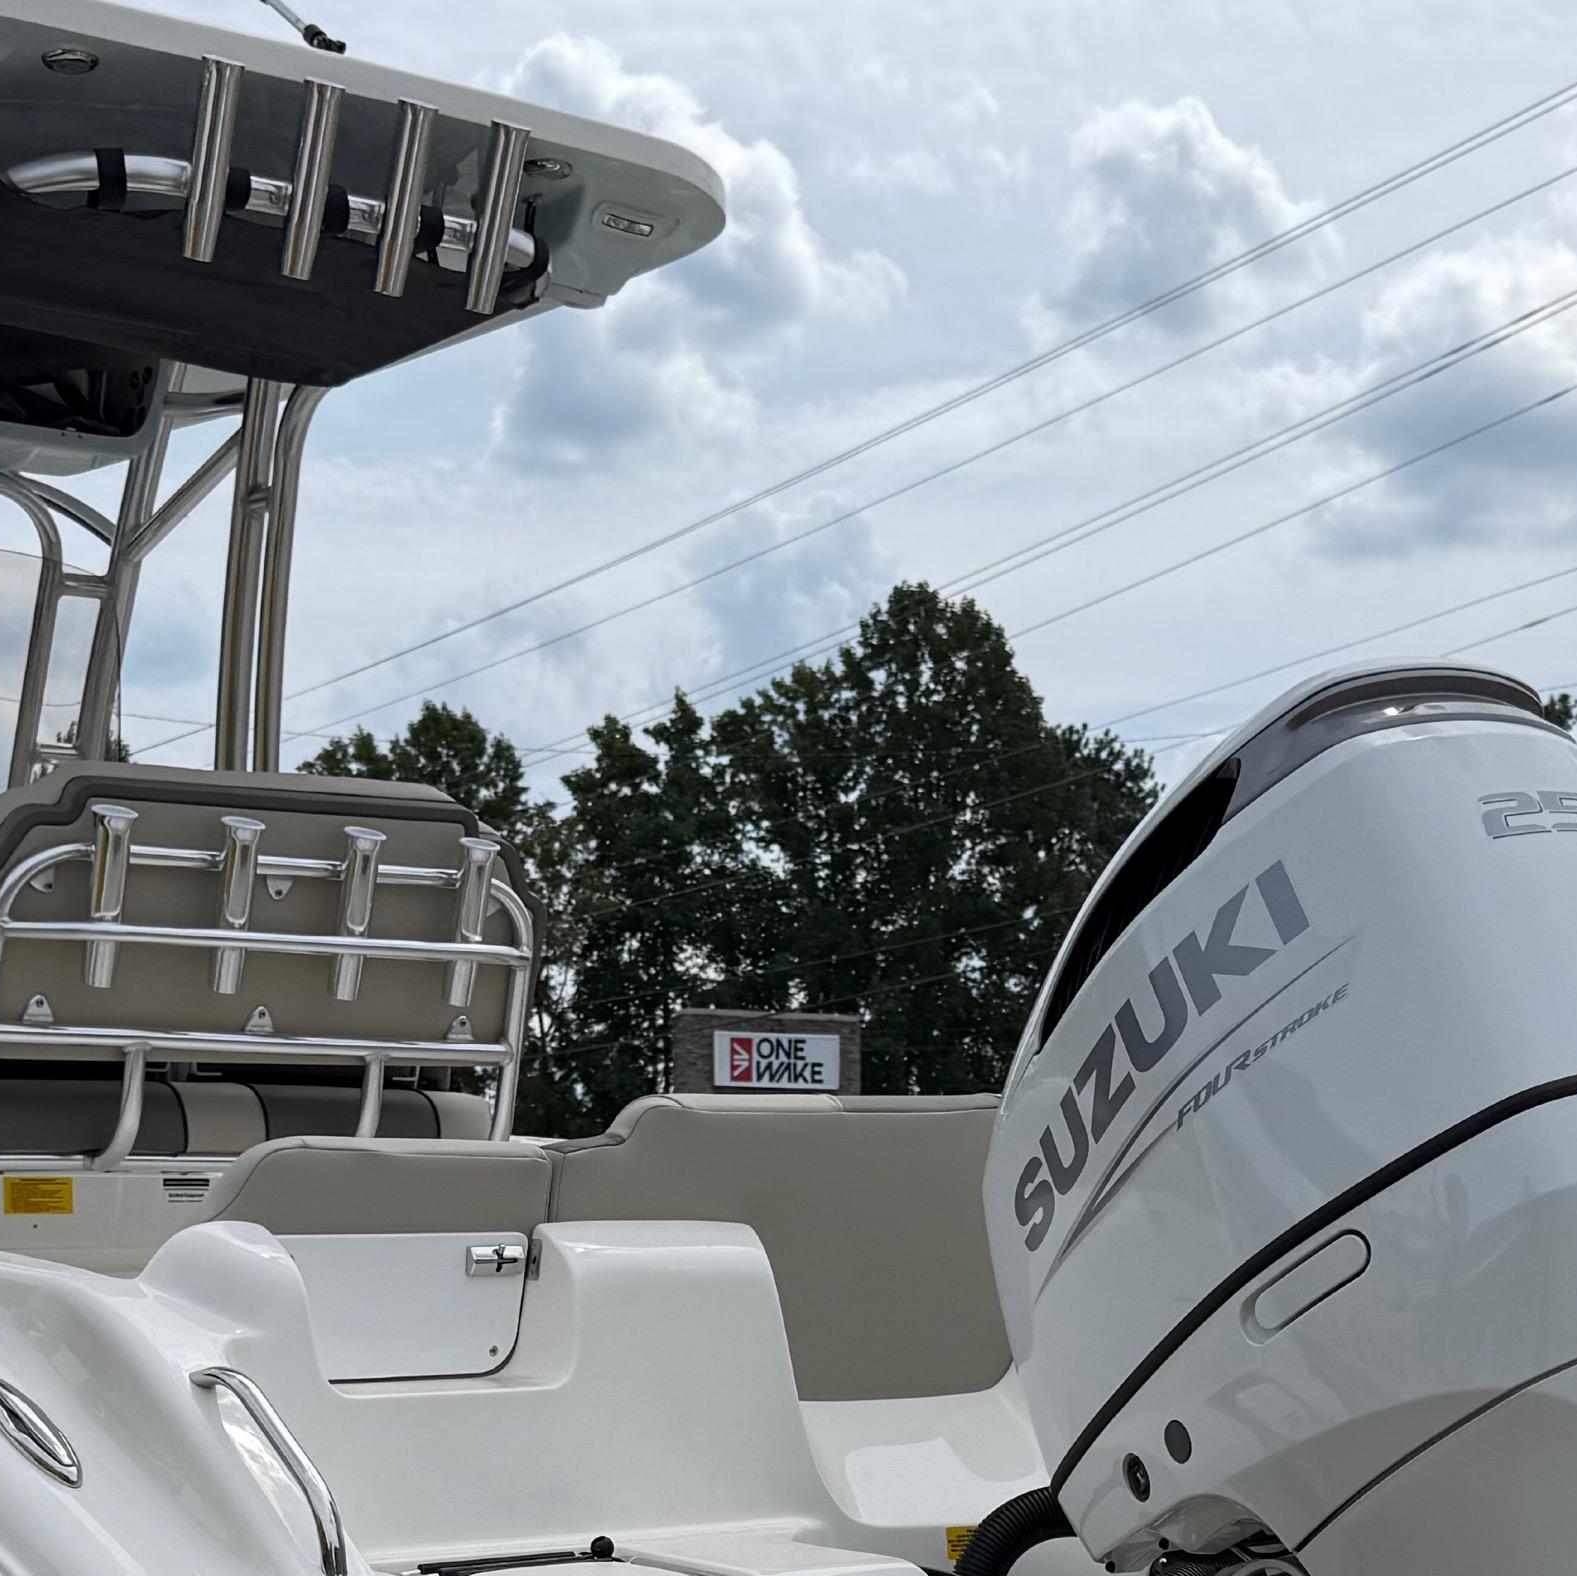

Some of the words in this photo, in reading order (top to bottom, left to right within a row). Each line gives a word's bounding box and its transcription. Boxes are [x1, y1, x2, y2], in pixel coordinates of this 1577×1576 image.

[756, 1037, 807, 1061] ONE
[1014, 858, 1311, 1252] SUZUKI
[755, 1060, 825, 1084] WAKE
